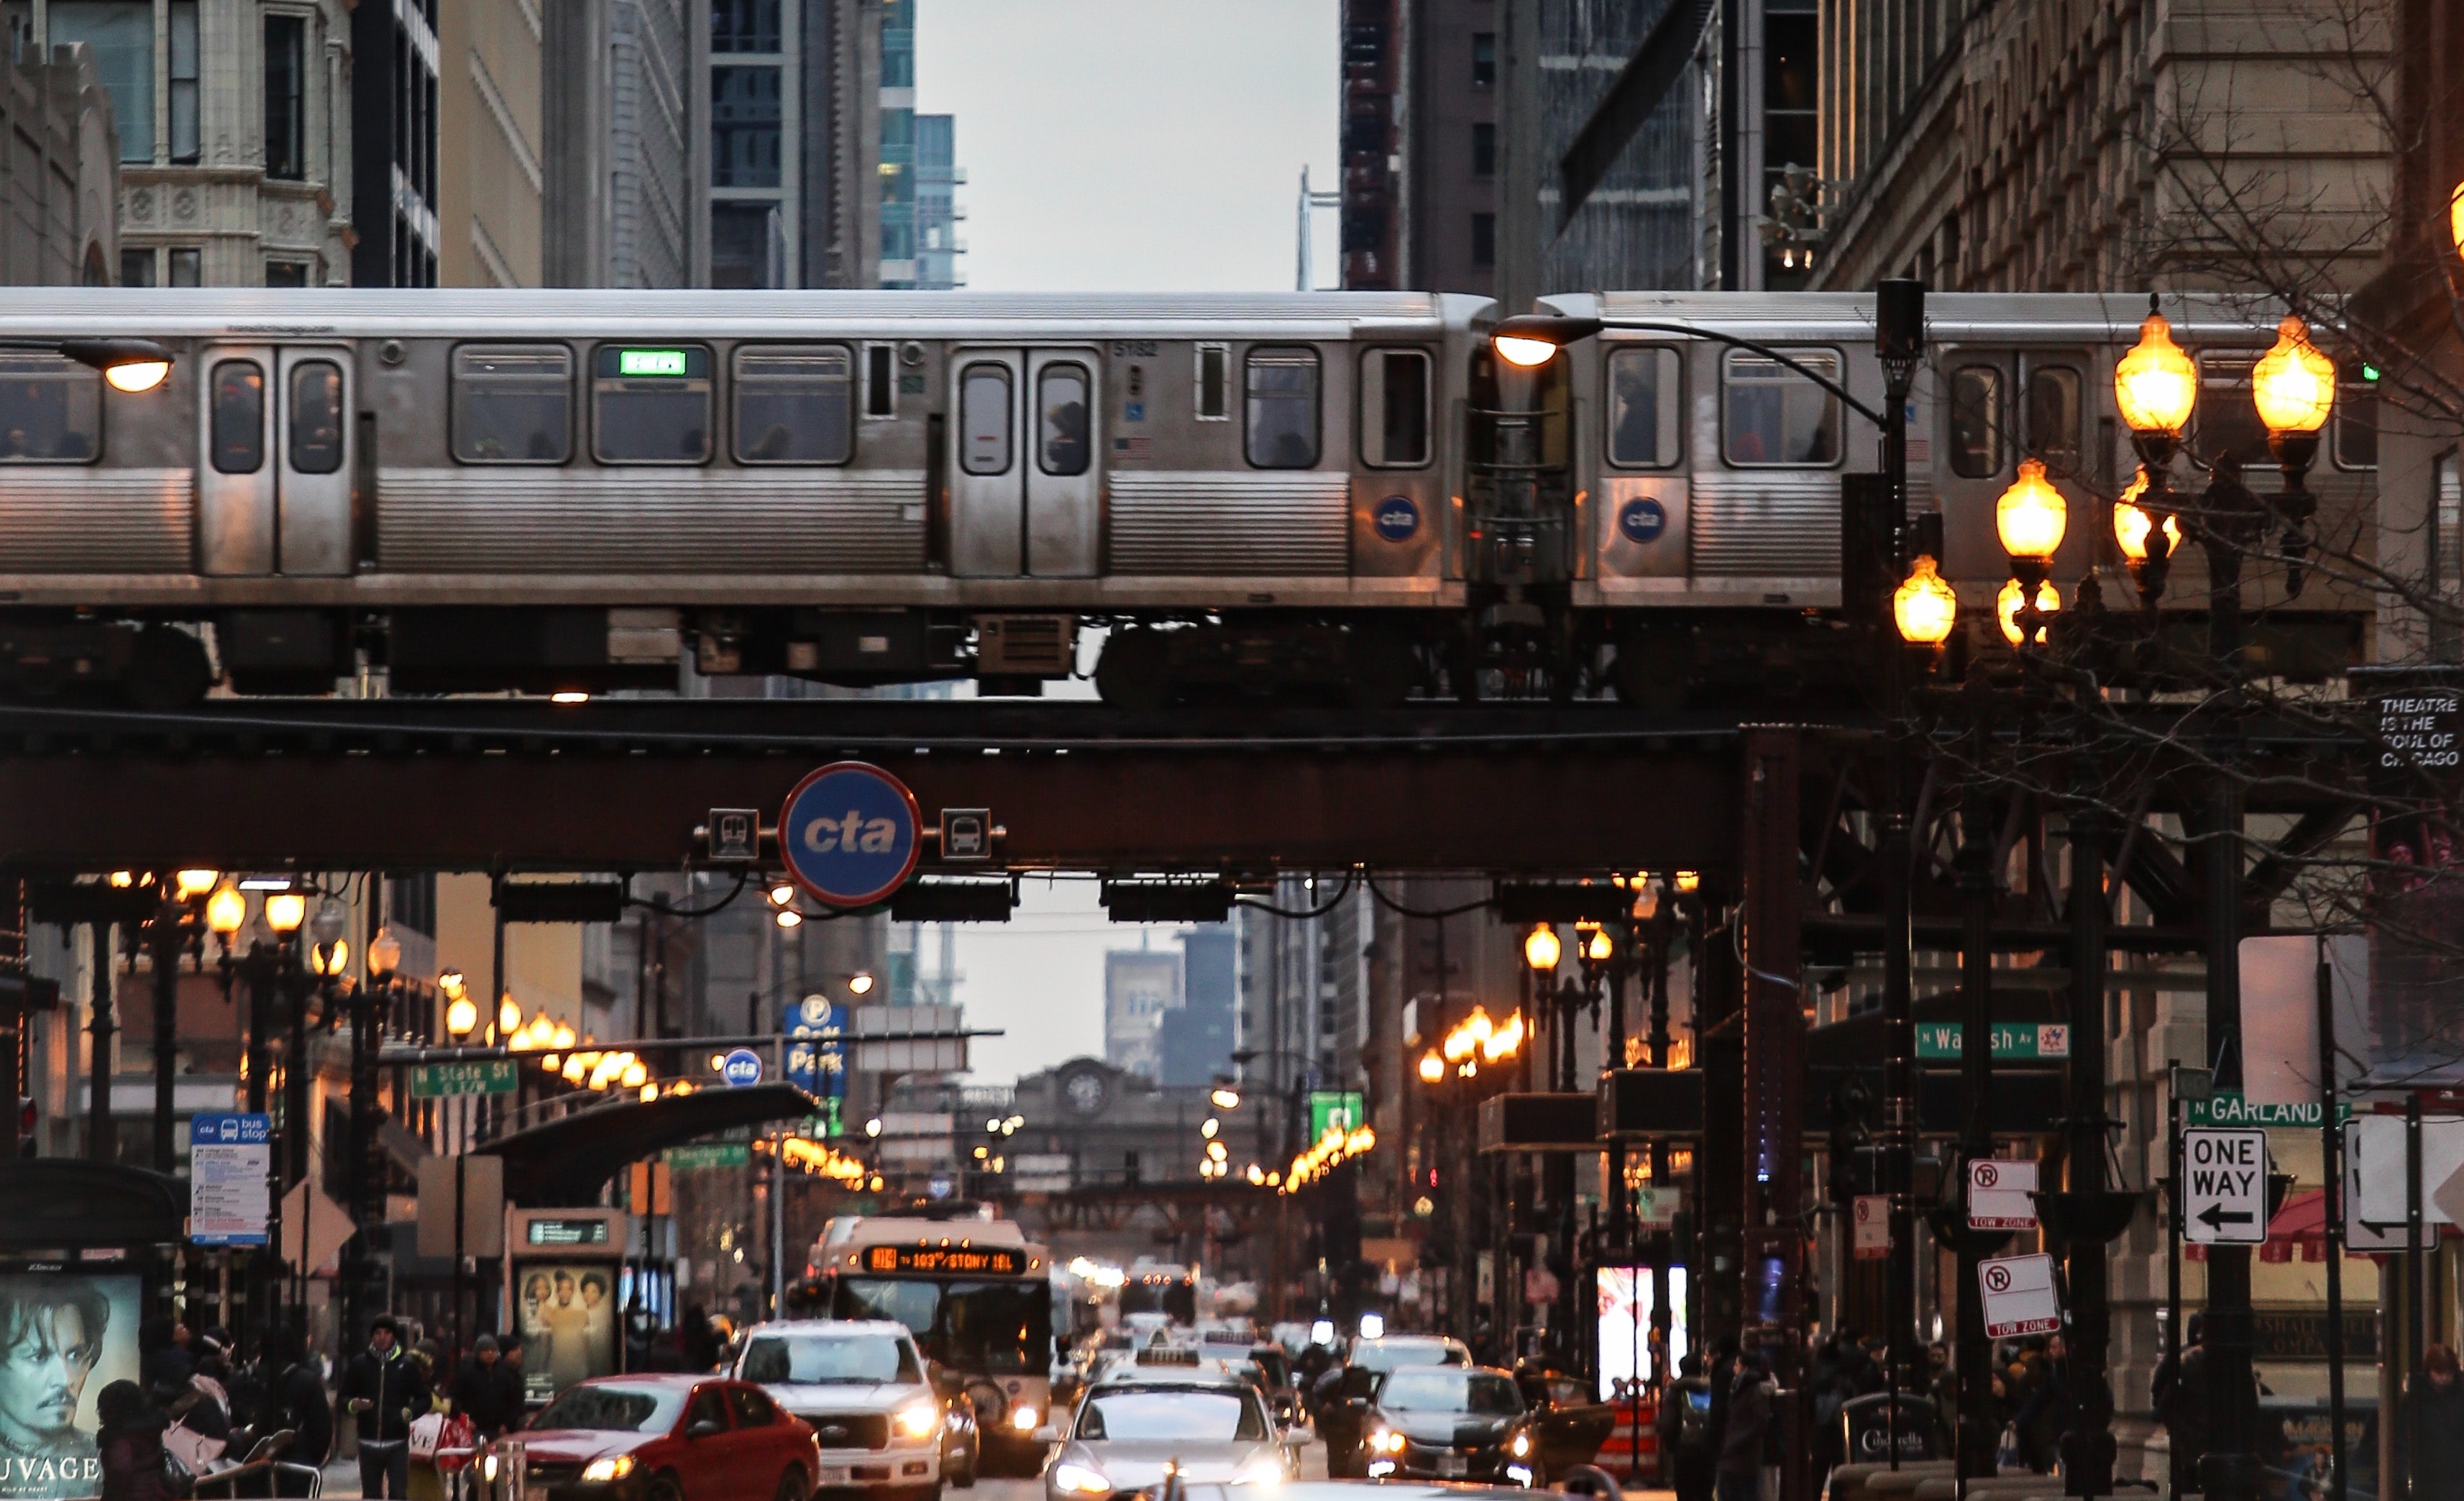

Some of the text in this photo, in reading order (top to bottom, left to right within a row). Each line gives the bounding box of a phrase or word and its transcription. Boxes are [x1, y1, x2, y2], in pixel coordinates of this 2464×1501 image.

[2381, 698, 2458, 713] THEATRE
[2430, 734, 2454, 748] OF
[804, 810, 897, 853] cta
[1923, 1032, 1930, 1043] N
[1936, 1028, 2012, 1050] Wash
[728, 1061, 757, 1077] cta
[2195, 1101, 2205, 1114] N
[2212, 1097, 2322, 1122] GARLAND
[242, 1118, 262, 1129] bus
[242, 1129, 267, 1141] stop
[2194, 1139, 2255, 1165] ONE
[2193, 1170, 2256, 1197] WAY
[1974, 1218, 2031, 1228] TOW ZONE
[2023, 1318, 2051, 1332] ZONE
[1861, 1429, 1923, 1453] Cindrella
